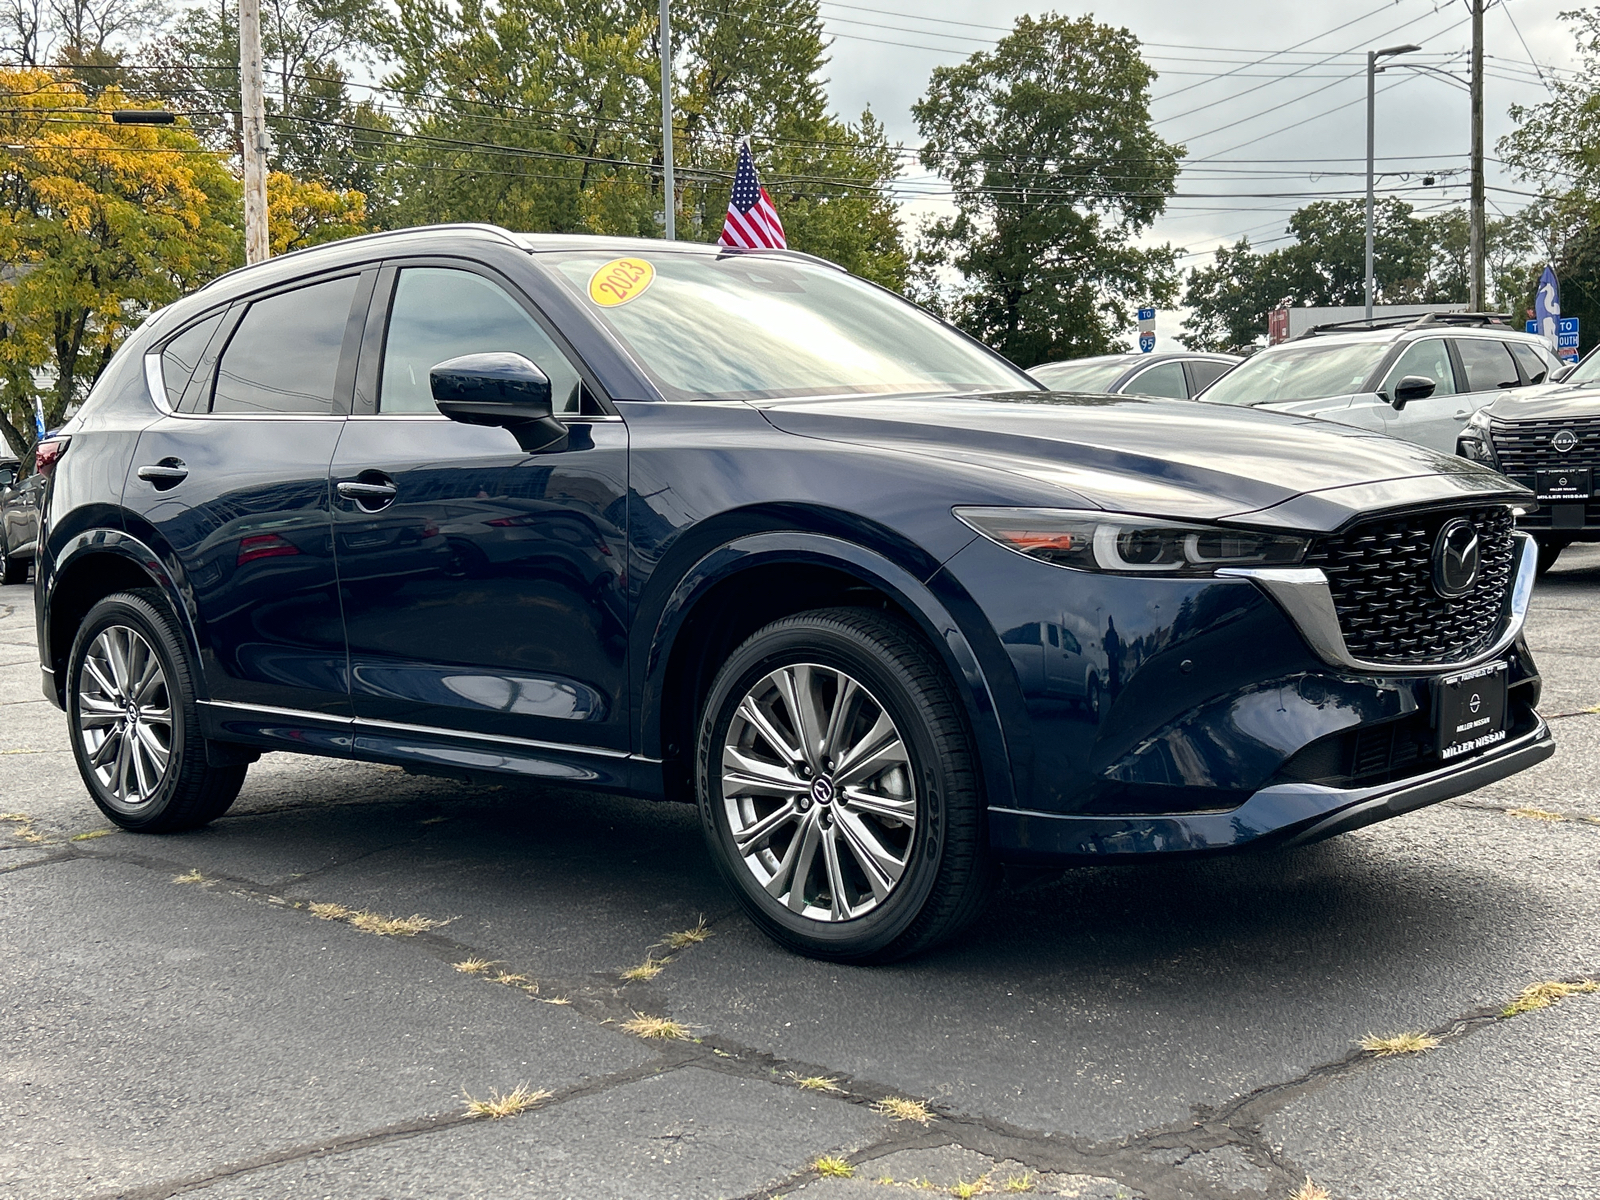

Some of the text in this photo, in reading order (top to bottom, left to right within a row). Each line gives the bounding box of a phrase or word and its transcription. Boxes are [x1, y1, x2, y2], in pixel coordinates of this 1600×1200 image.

[600, 261, 645, 299] 2023
[1560, 322, 1572, 331] TO
[1141, 339, 1154, 350] 95
[1560, 336, 1578, 346] OUTH
[1456, 716, 1490, 732] MILLER NISSAN
[1442, 730, 1506, 759] MILLER NISSAN
[926, 767, 939, 861] TOYO
